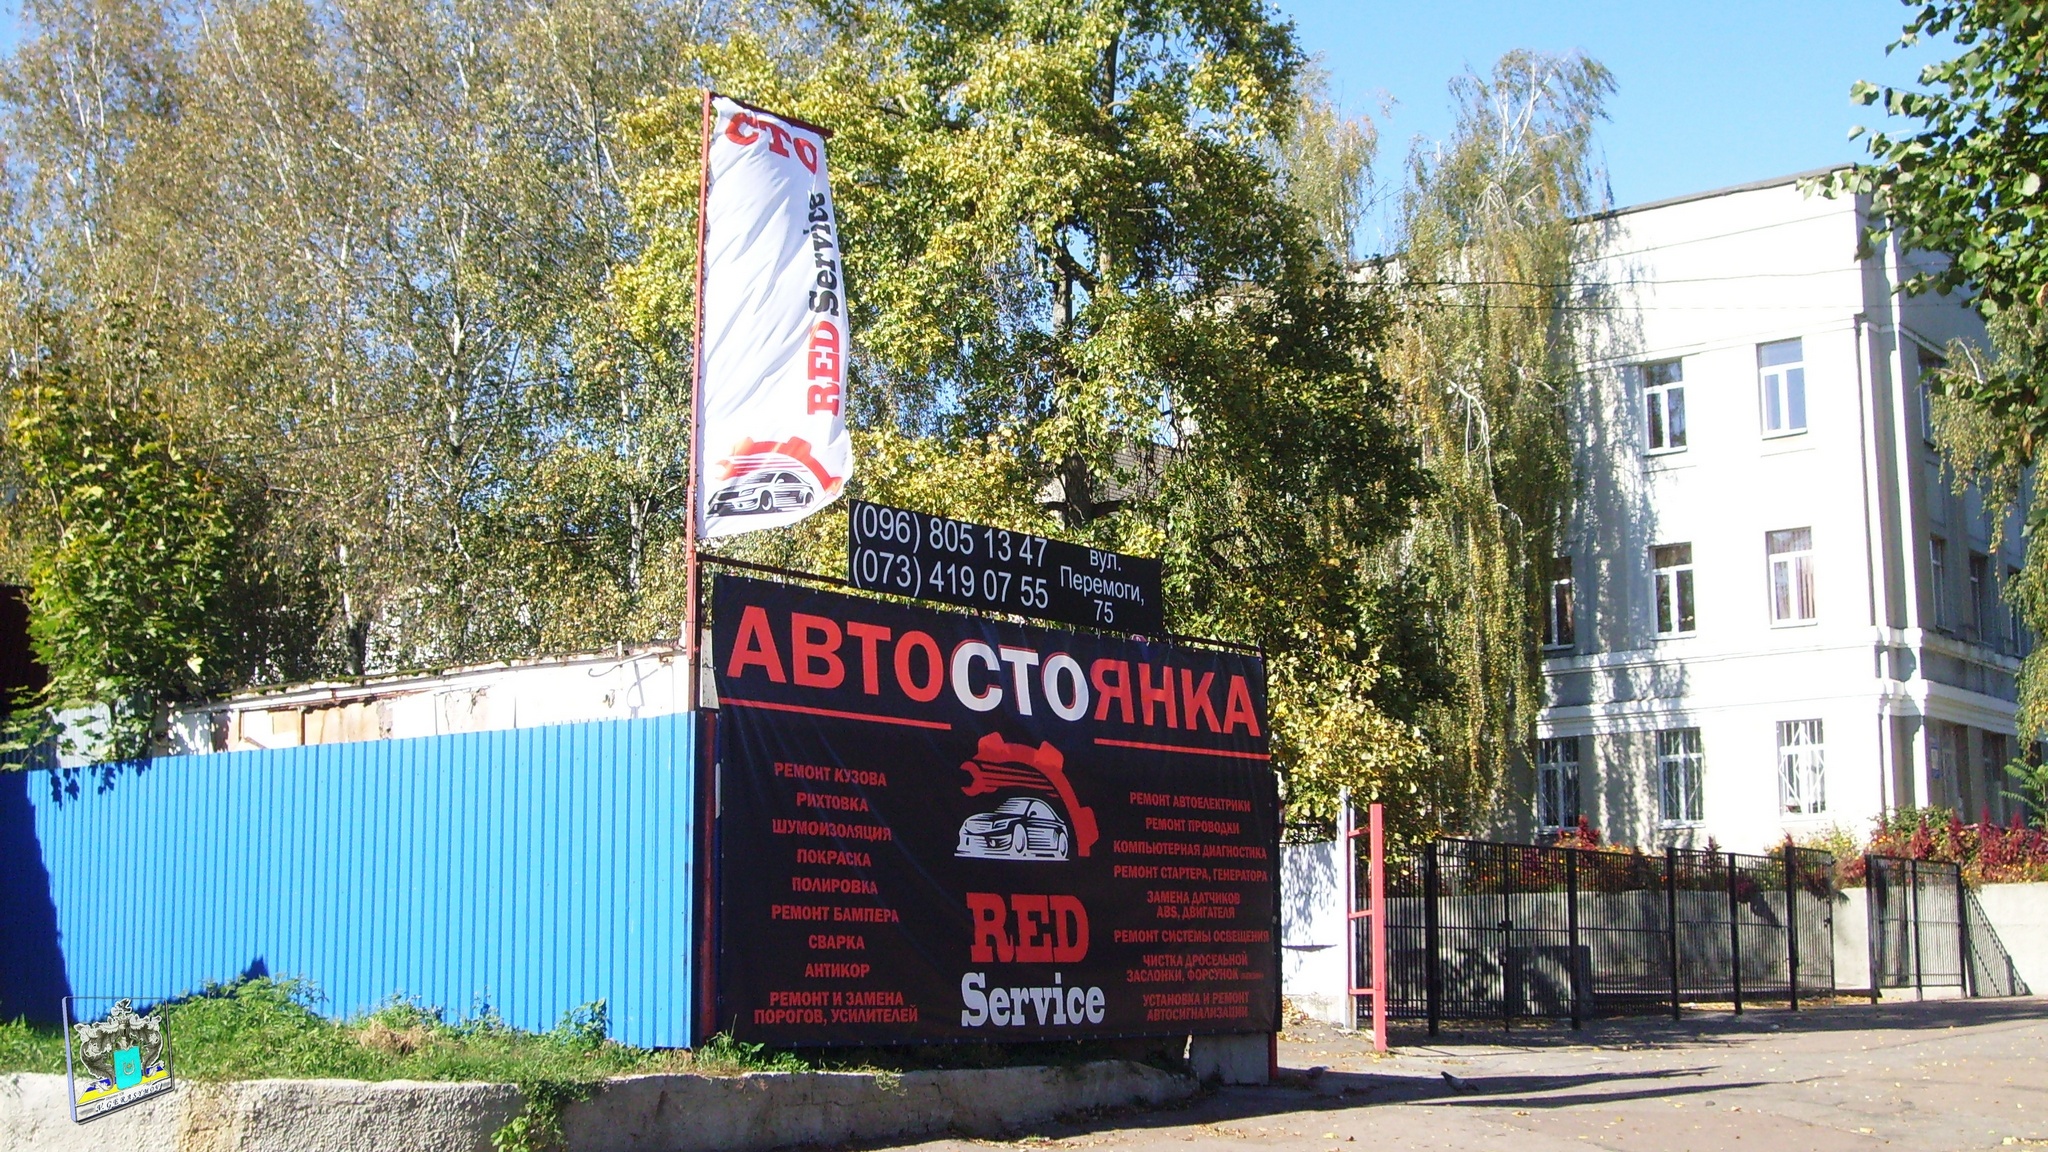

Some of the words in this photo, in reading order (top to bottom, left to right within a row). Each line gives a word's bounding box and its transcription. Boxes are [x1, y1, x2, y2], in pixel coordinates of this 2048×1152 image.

[725, 112, 817, 175] СТО
[803, 192, 839, 315] Service
[807, 320, 840, 416] RED
[852, 503, 920, 553] (096)
[930, 518, 974, 555] 805
[984, 529, 1011, 561] 13
[1019, 536, 1047, 567] 47
[1090, 549, 1121, 573] вул.
[852, 547, 921, 597] (073)
[929, 561, 974, 597] 419
[983, 569, 1011, 602] 07
[1021, 578, 1048, 608] 55
[1060, 565, 1144, 606] Перемоги,
[1094, 600, 1113, 624] 75
[726, 605, 1260, 737] АВТОСТОЯНКА
[774, 762, 831, 781] РЕМОНТ
[835, 768, 887, 786] КУЗОВА
[796, 792, 869, 811] РИХТОВКА
[1130, 792, 1170, 807] РЕМОНТ
[772, 819, 892, 842] ШУМОИЗОЛЯЦИЯ
[1146, 817, 1185, 831] РЕМОНТ
[1188, 820, 1239, 835] ПРОВОДКИ
[797, 849, 871, 867] ПОКРАСКА
[1114, 840, 1200, 856] КОМПЬЮТЕРНАЯ
[1202, 845, 1267, 859] ДИАГНОСТИКА
[1114, 865, 1158, 878] РЕМОНТ
[1161, 867, 1211, 882] СТАРТЕРА,
[1213, 869, 1267, 882] ГЕНЕРАТОРА
[792, 877, 878, 894] ПОЛИРОВКА
[1147, 891, 1189, 903] ЗАМЕНА
[1192, 892, 1240, 905] ДАТЧИКОВ
[771, 905, 829, 920] РЕМОНТ
[834, 908, 899, 922] БАМПЕРА
[1157, 907, 1180, 919] ABS,
[1182, 907, 1235, 920] ДВИГАТЕЛЯ
[966, 892, 1089, 962] RED
[809, 935, 865, 949] СВАРКА
[1114, 930, 1158, 942] РЕМОНТ
[1162, 930, 1210, 942] СИСТЕМЫ
[1214, 930, 1269, 944] ОСВЕЩЕНИЯ
[1143, 954, 1183, 967] ЧИСТКА
[1185, 951, 1248, 968] ДРОСЕЛЬНОЙ
[805, 963, 870, 977] АНТИКОР
[1127, 970, 1184, 983] ЗАСЛОНКИ,
[1187, 968, 1239, 981] ФОРСУНОК
[770, 992, 829, 1006] РЕМОНТ
[833, 992, 842, 1005] И
[846, 992, 903, 1005] ЗАМЕНА
[961, 972, 1105, 1026] Service
[1143, 993, 1200, 1006] УСТАНОВКА
[1203, 993, 1210, 1004] И
[1213, 992, 1249, 1005] РЕМОНТ
[754, 1009, 827, 1026] ПОРОГОВ,
[831, 1005, 918, 1022] УСИЛИТЕЛЕЙ
